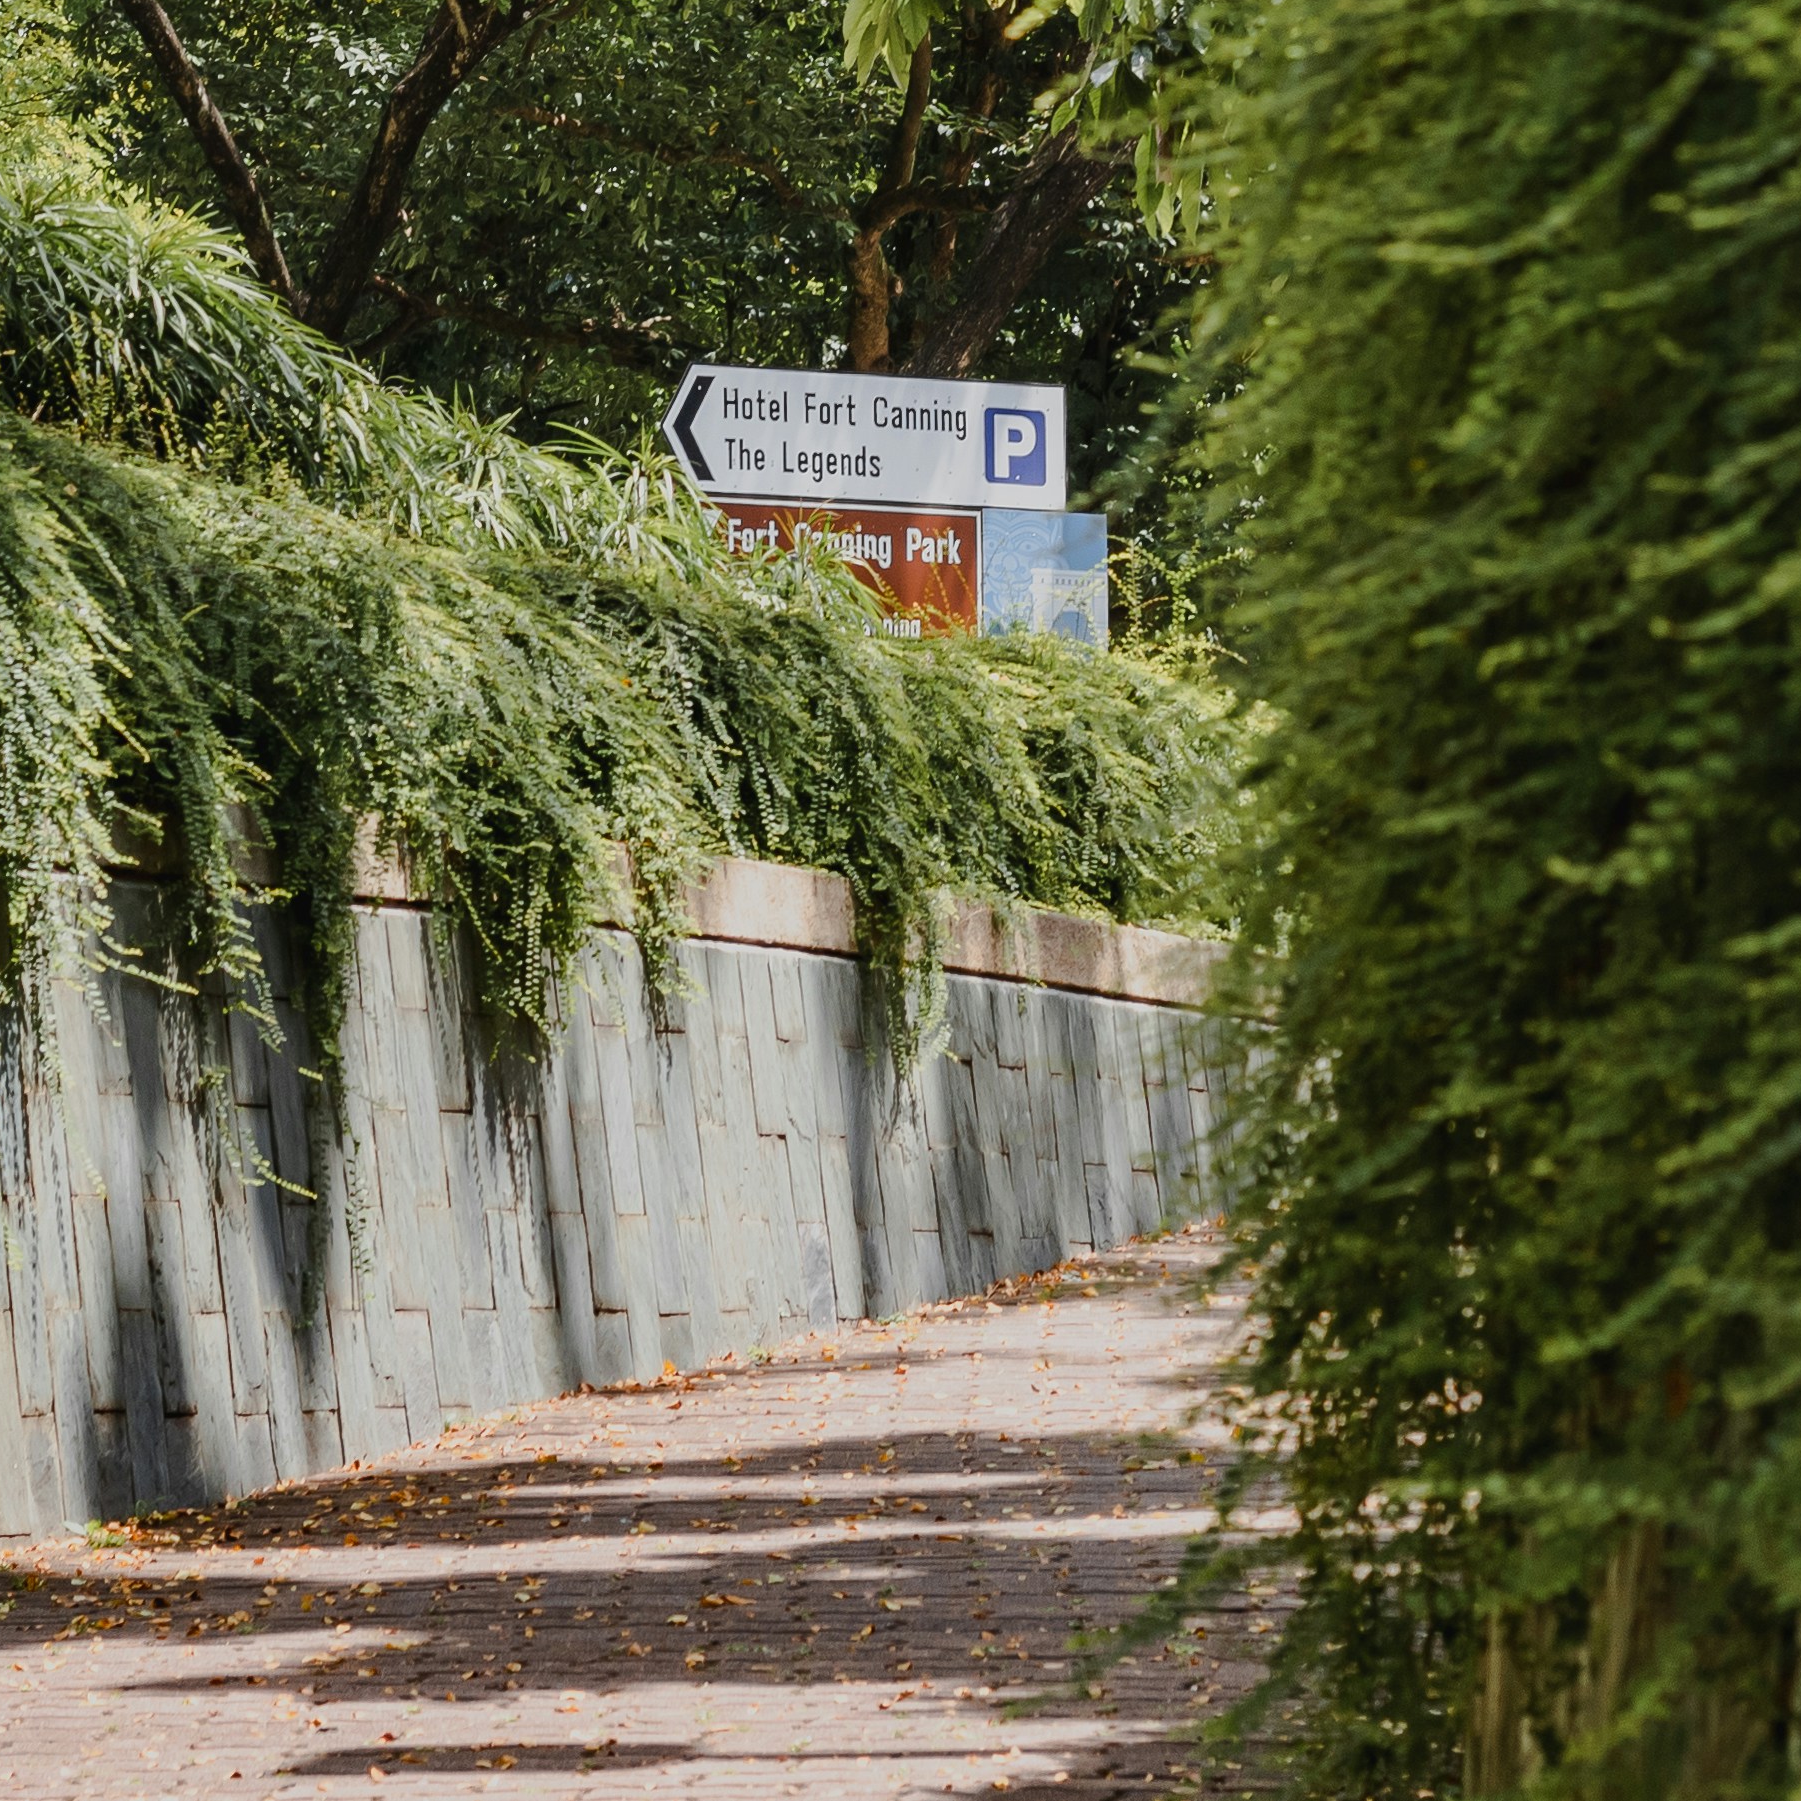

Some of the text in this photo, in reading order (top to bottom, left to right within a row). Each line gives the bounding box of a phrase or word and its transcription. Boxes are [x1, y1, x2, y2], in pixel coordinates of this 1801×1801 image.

[722, 387, 967, 441] Hotel Fort Canning
[724, 438, 882, 483] The Legends
[993, 413, 1037, 479] P
[727, 517, 780, 554] Fort
[905, 526, 963, 565] Park
